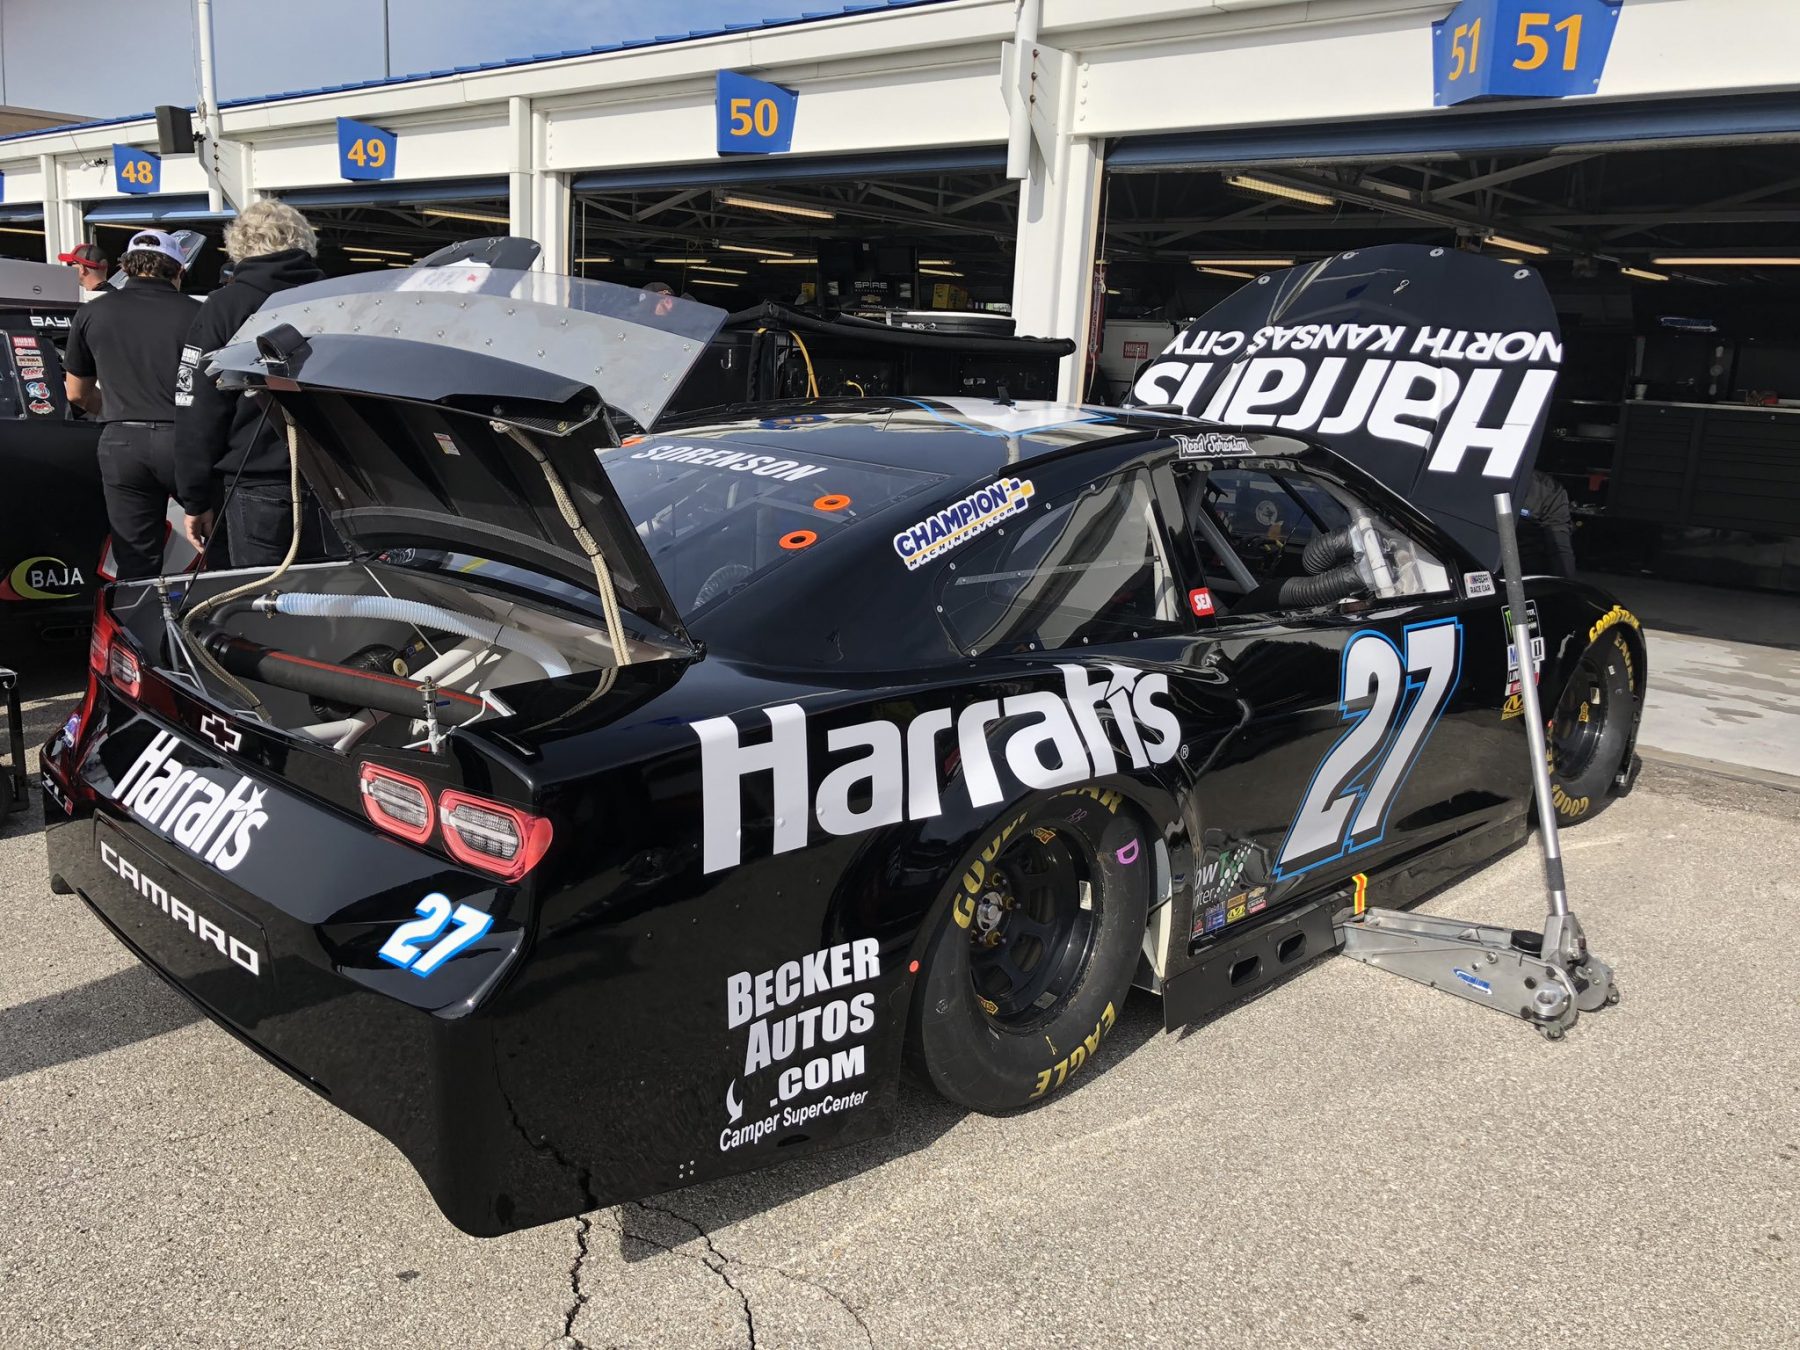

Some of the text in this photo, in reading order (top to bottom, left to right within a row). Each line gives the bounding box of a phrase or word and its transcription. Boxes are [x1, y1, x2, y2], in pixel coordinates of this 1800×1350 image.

[1448, 18, 1481, 81] 51
[1512, 13, 1582, 70] 51
[729, 98, 779, 137] 50
[121, 160, 153, 184] 48
[347, 138, 386, 168] 49
[1161, 323, 1563, 363] NORTH KANSAS CITY
[631, 445, 829, 482] SORENSON
[896, 483, 1008, 557] CHAMPION
[31, 565, 85, 588] BAJA
[1274, 618, 1462, 880] 27
[101, 840, 260, 977] CAMARO
[378, 892, 495, 978] 27
[727, 937, 881, 1030] BECKER
[744, 992, 876, 1077] AUTOS
[1029, 1001, 1117, 1099] EAGLE
[769, 1045, 866, 1108] .COM
[719, 1090, 869, 1152] Camper SuperCenter
